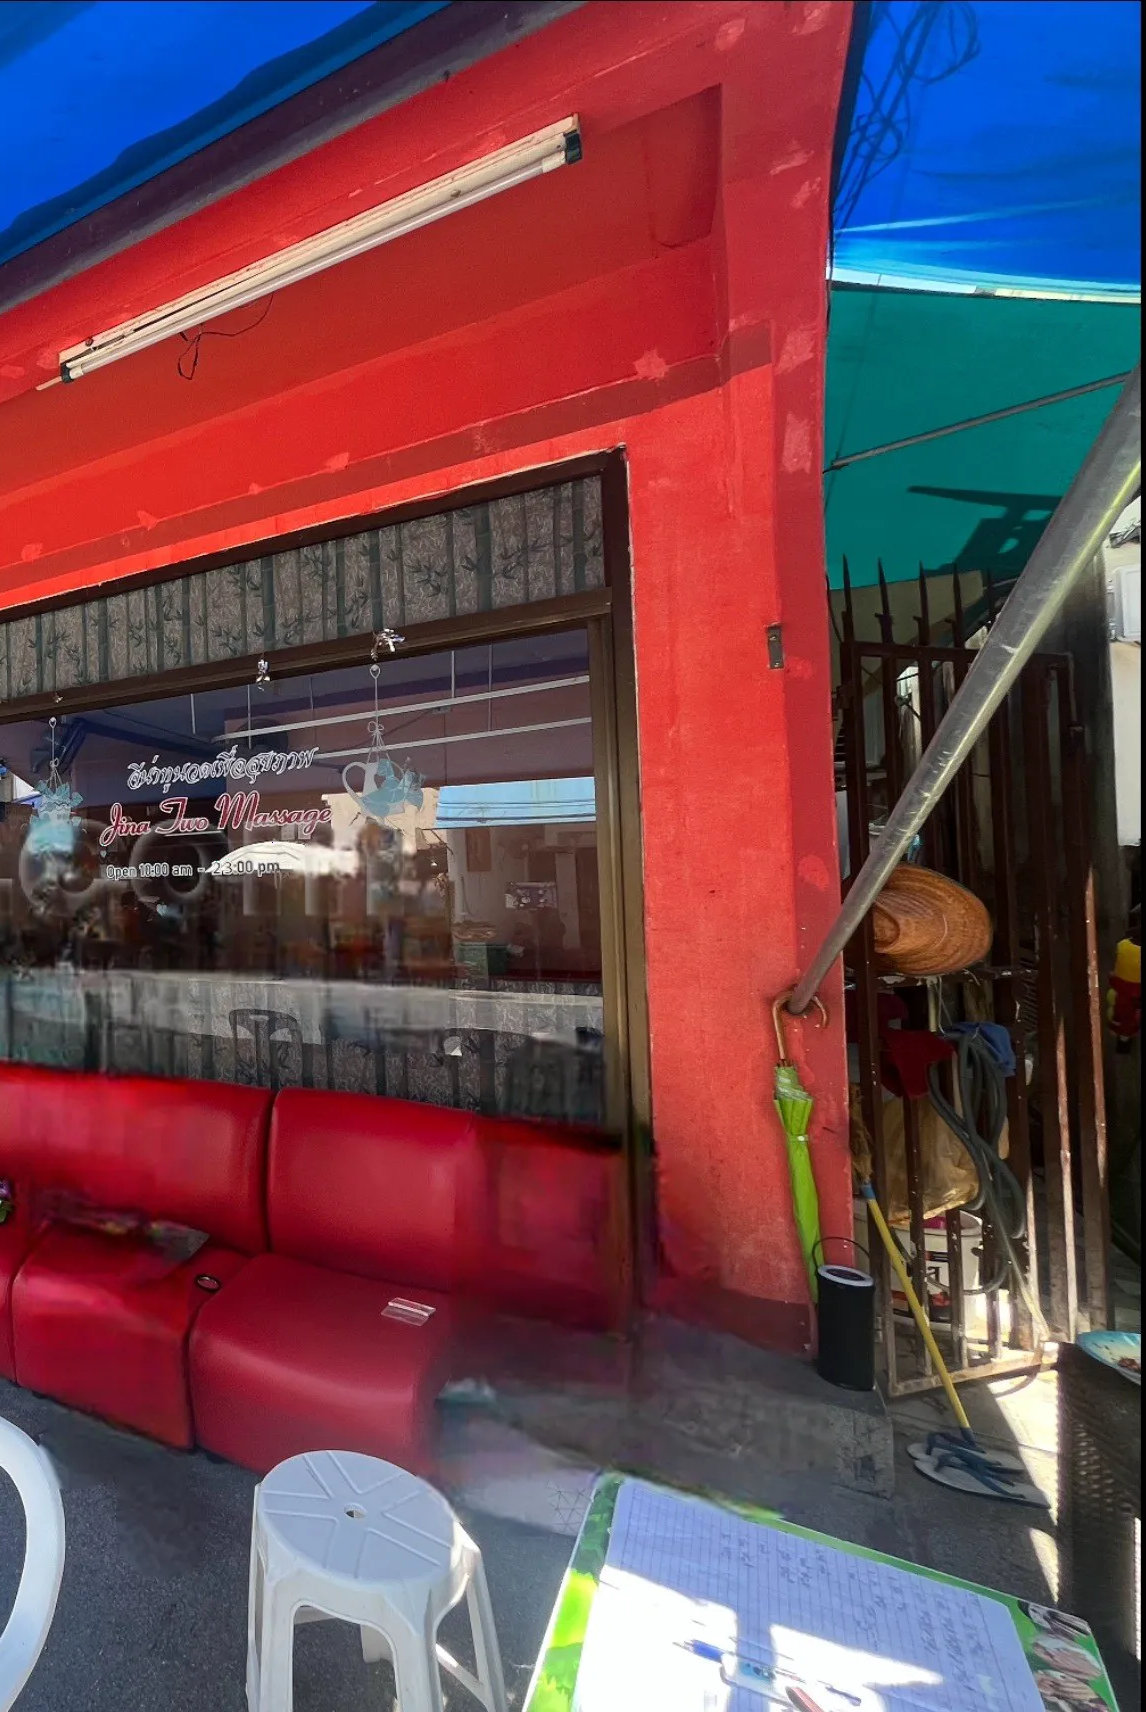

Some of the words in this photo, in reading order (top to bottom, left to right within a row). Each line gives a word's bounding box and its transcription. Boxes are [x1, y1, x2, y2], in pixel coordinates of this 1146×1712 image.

[99, 803, 151, 847] Jina
[156, 797, 209, 835] Two
[214, 790, 333, 835] Massage
[106, 865, 137, 881] Open
[139, 862, 170, 878] 10:00
[171, 864, 194, 877] am
[257, 861, 282, 877] pm
